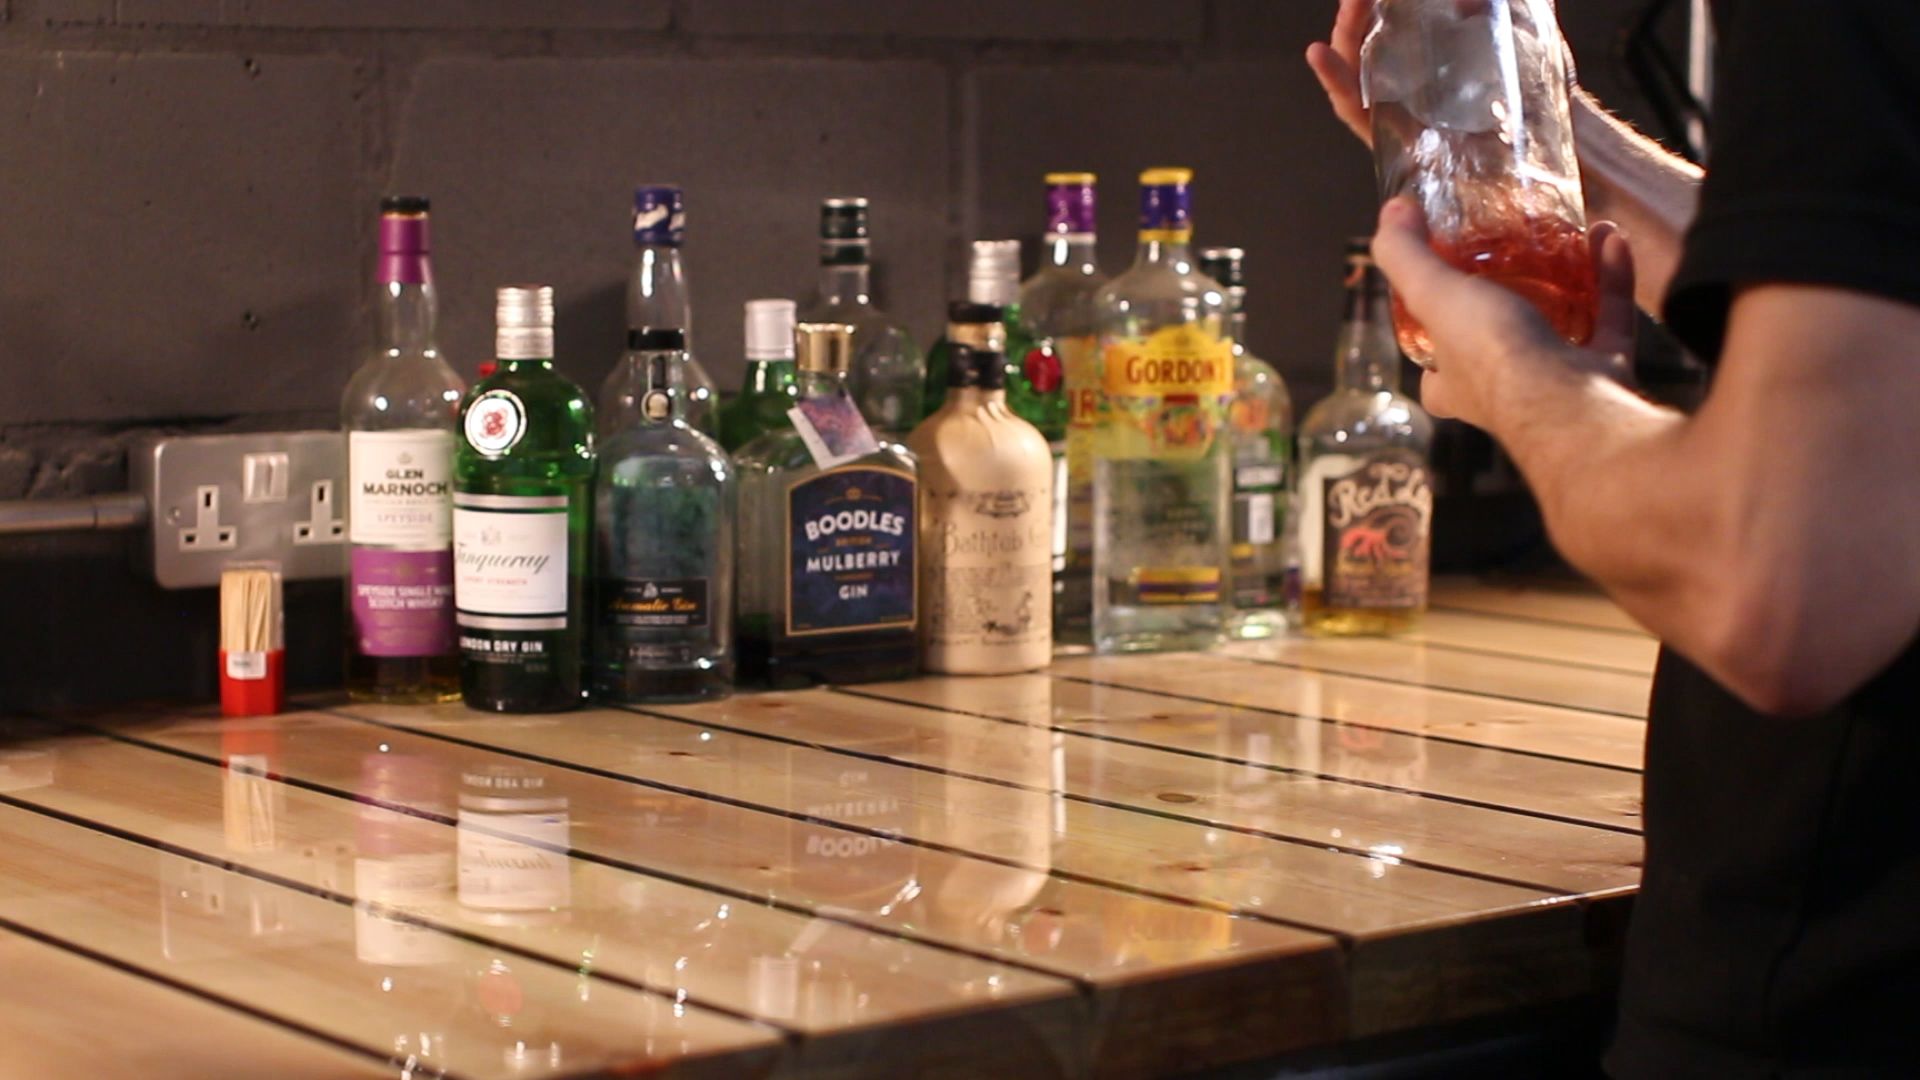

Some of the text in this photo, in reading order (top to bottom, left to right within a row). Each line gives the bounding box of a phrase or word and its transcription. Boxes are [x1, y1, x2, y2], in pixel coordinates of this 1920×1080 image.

[385, 469, 424, 480] GLEN
[363, 482, 448, 496] MARNOCH
[805, 510, 905, 541] BOODLES
[806, 550, 901, 573] MULBERRY
[839, 584, 869, 600] GIN
[494, 640, 518, 653] DRY
[521, 641, 543, 653] GIN
